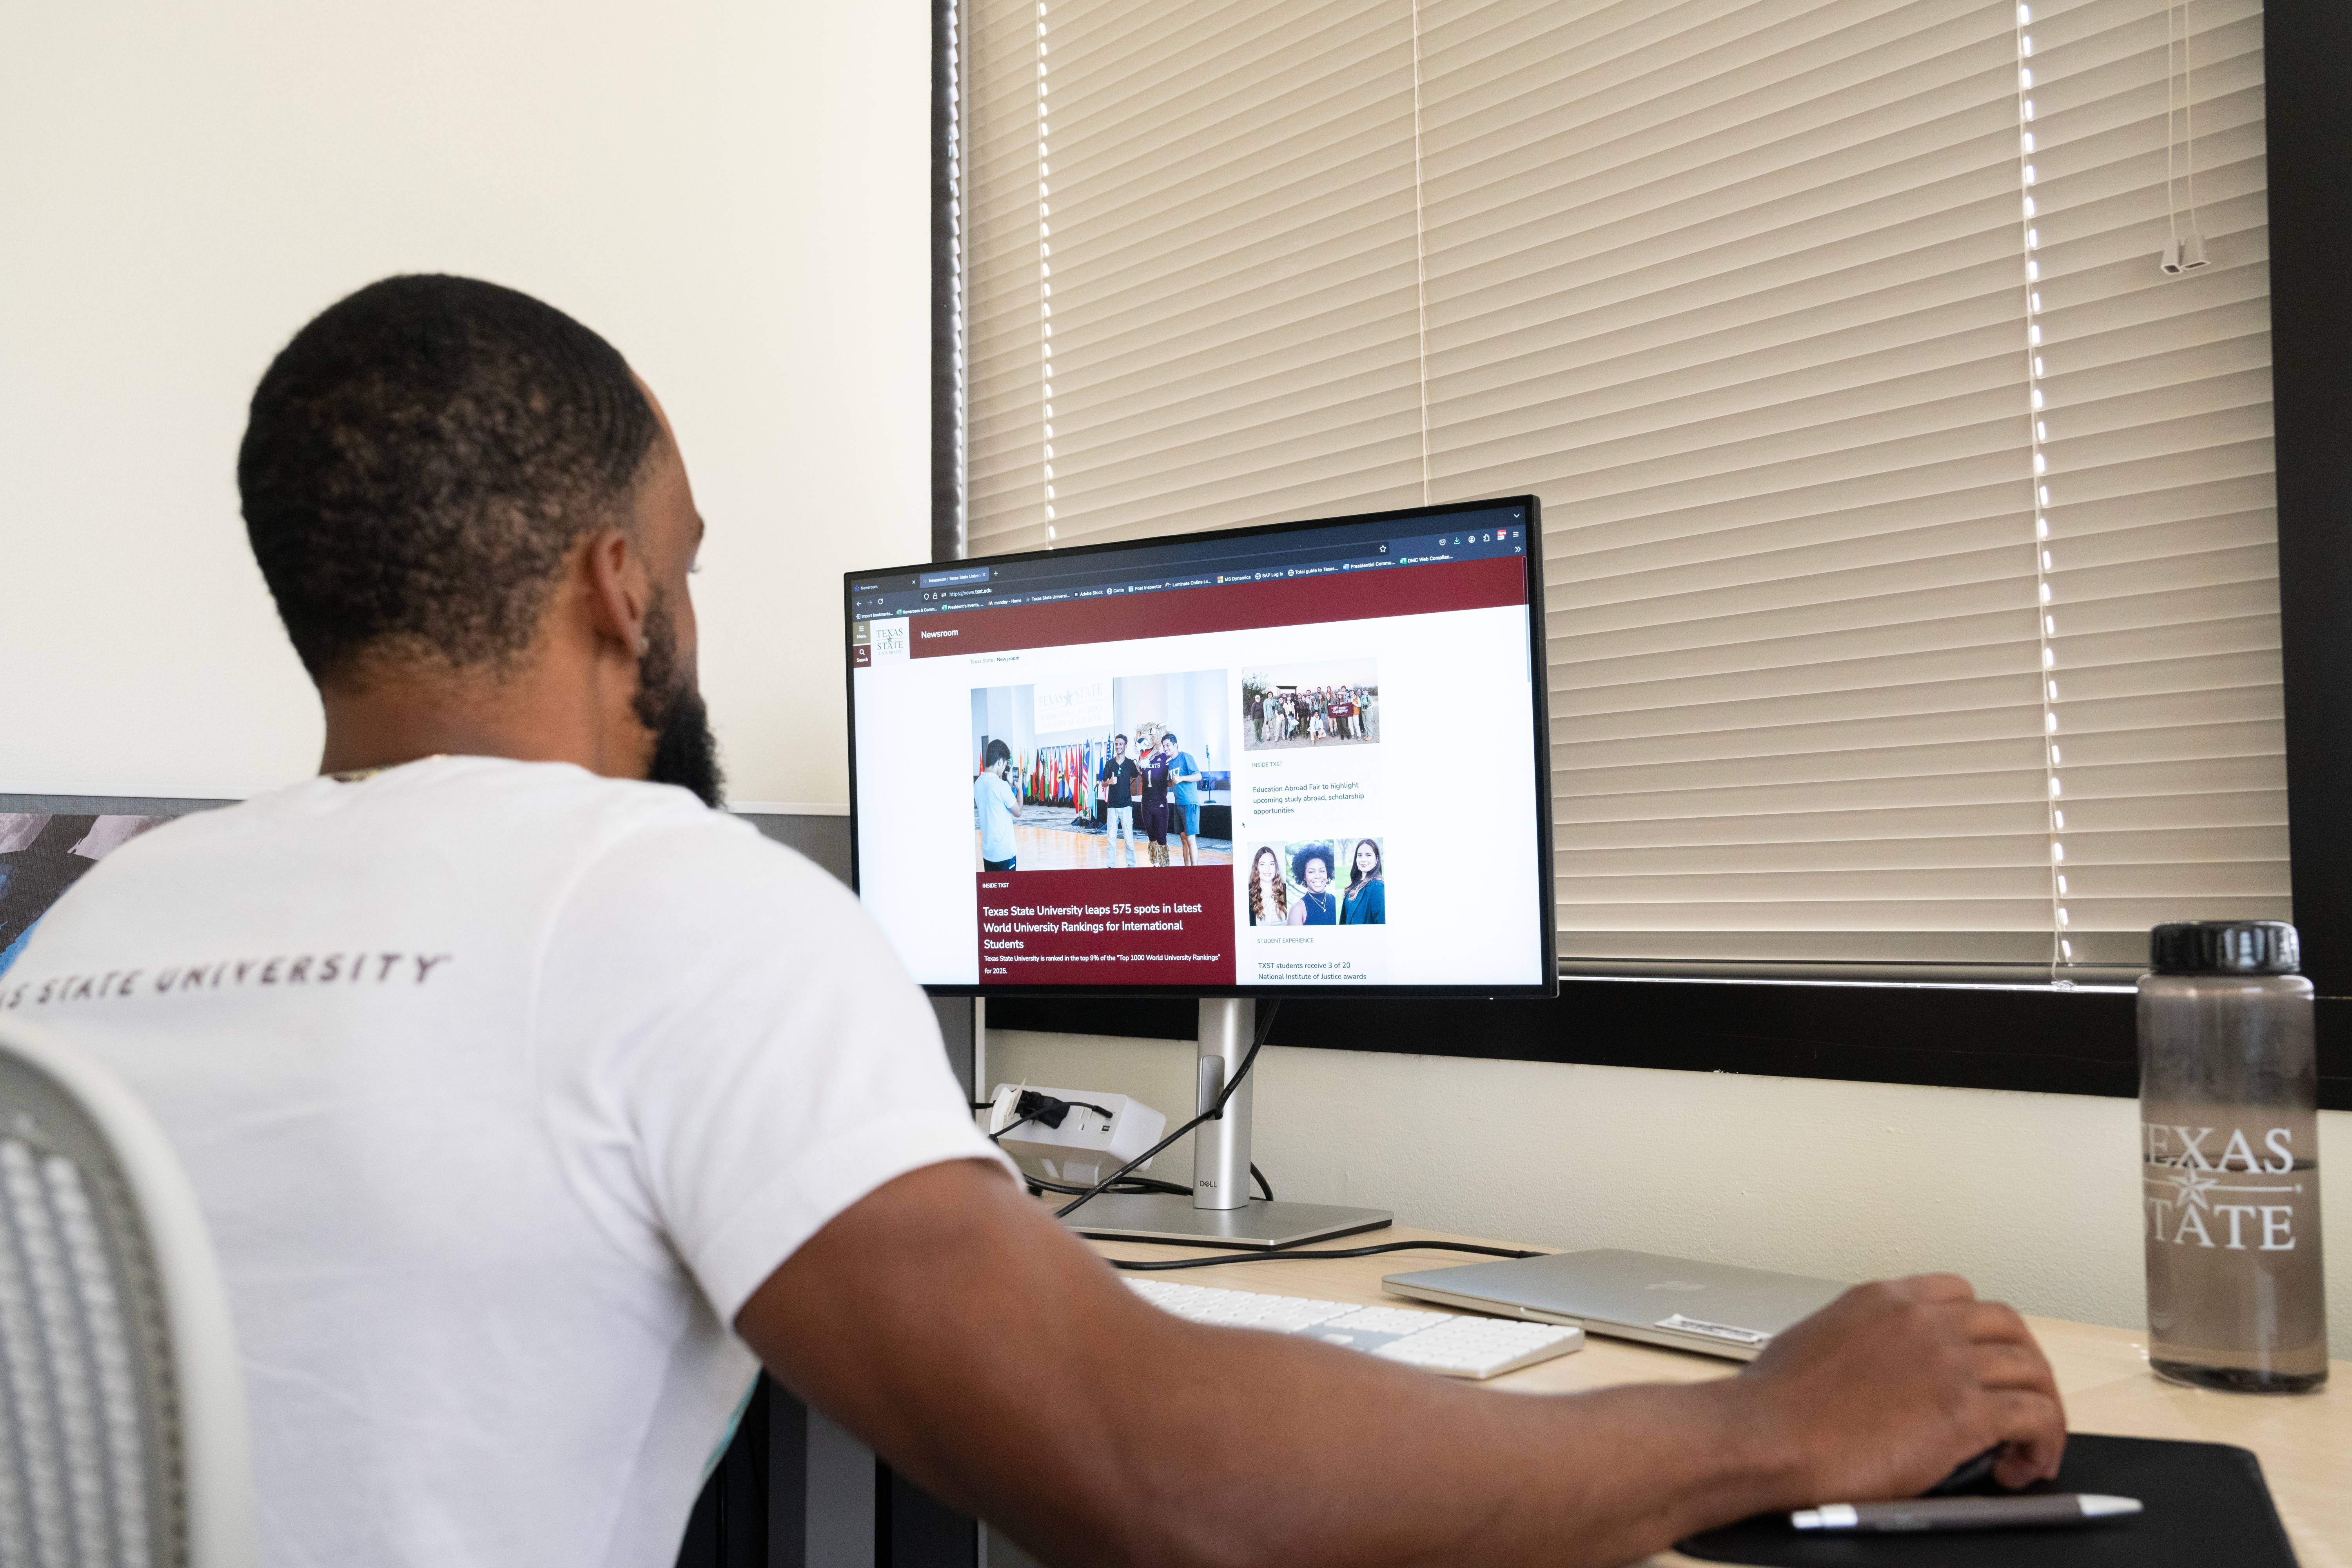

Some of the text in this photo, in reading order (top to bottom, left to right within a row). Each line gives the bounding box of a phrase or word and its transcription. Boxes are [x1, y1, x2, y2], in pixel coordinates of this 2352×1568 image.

[949, 588, 992, 597] https://news.txst.edu
[876, 628, 903, 638] TEXAS
[921, 630, 958, 639] Newsroom
[877, 641, 903, 650] STATE
[1148, 770, 1152, 787] 1
[1330, 782, 1359, 790] highlight
[1254, 807, 1294, 815] opportunities
[983, 903, 1202, 916] Texas State University leaps 575 spots in latest
[983, 920, 1183, 934] World University Rankings for International
[984, 939, 1024, 949] Students
[37, 967, 147, 1006] STATE
[154, 953, 454, 995] UNIVERSITY
[2141, 1122, 2295, 1175] EXAS
[2149, 1197, 2297, 1251] TATE
